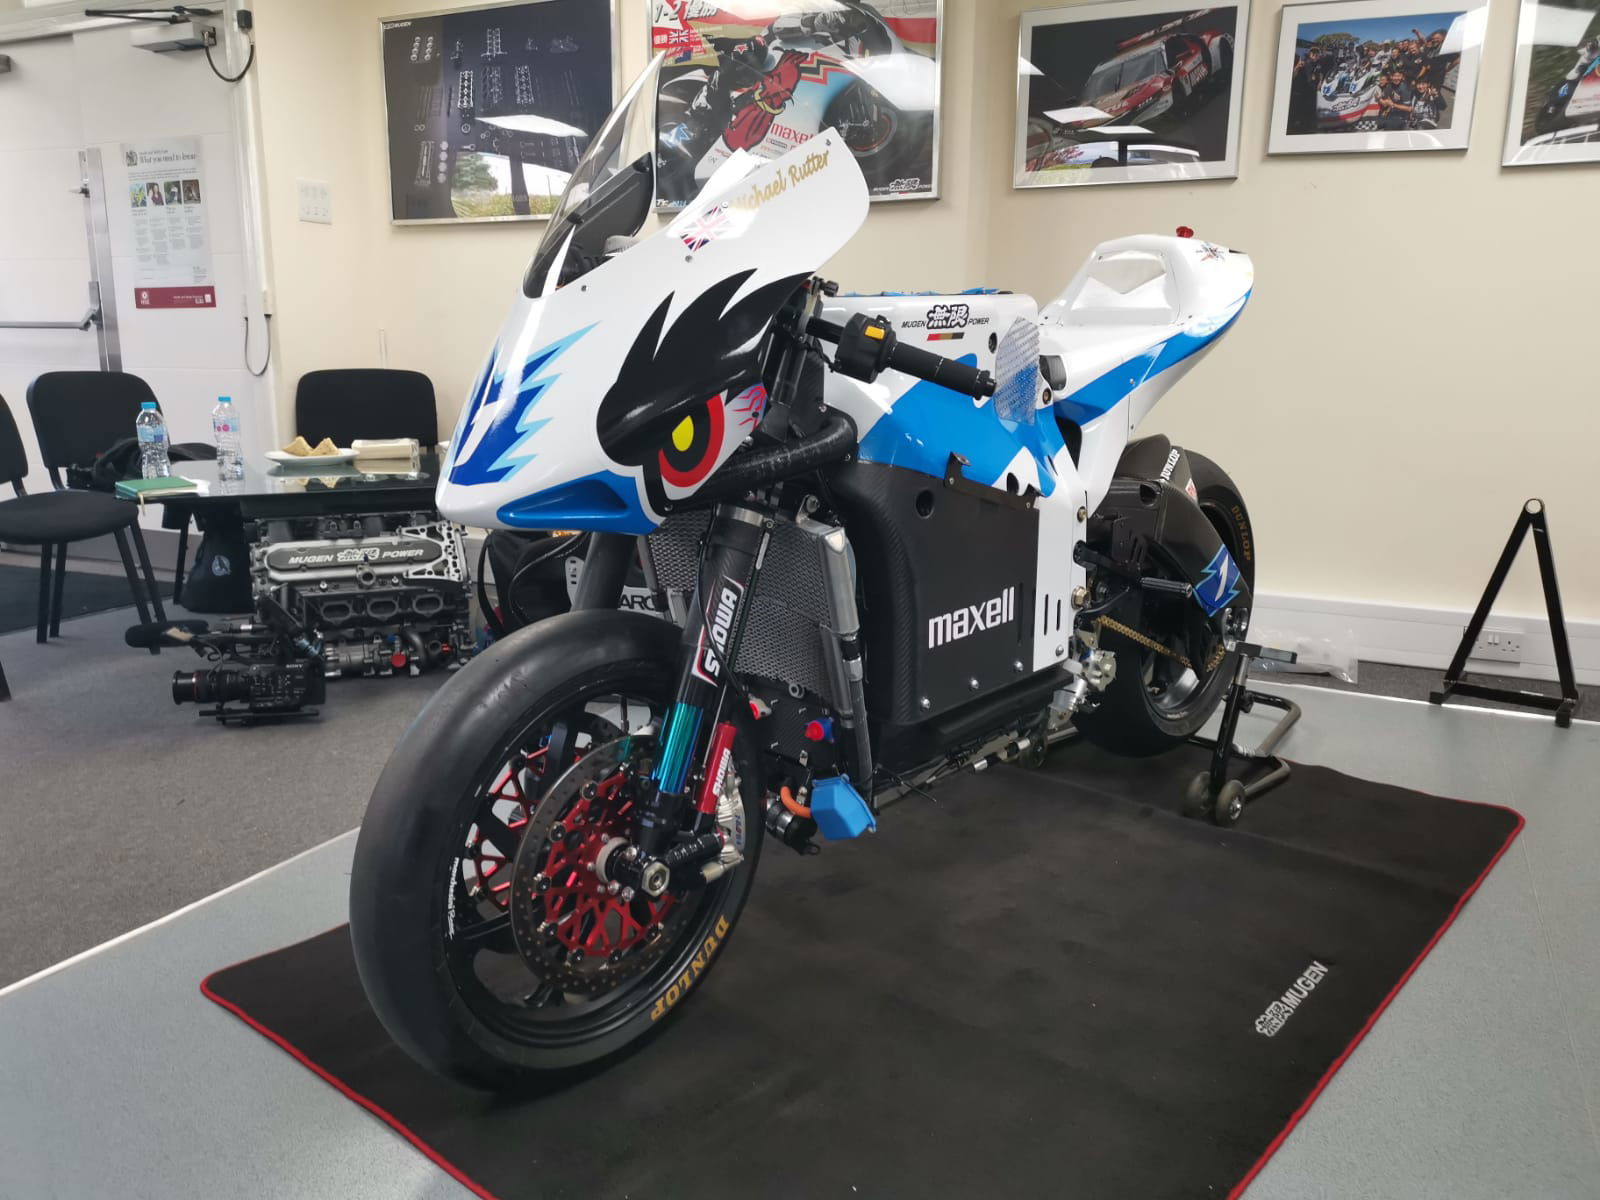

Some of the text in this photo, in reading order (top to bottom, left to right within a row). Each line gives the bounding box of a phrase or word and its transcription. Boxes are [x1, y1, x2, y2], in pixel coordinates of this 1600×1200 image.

[787, 149, 830, 188] Rutter
[901, 304, 990, 329] MUGEN 無限 POWER
[1160, 449, 1180, 480] DUNLOP
[1232, 504, 1251, 561] DUNLOP
[288, 554, 334, 564] MUGEN
[382, 549, 424, 558] POWER
[928, 586, 1015, 649] maxell
[650, 915, 729, 1022] DUNLOP
[1281, 960, 1329, 1010] MUGEN
